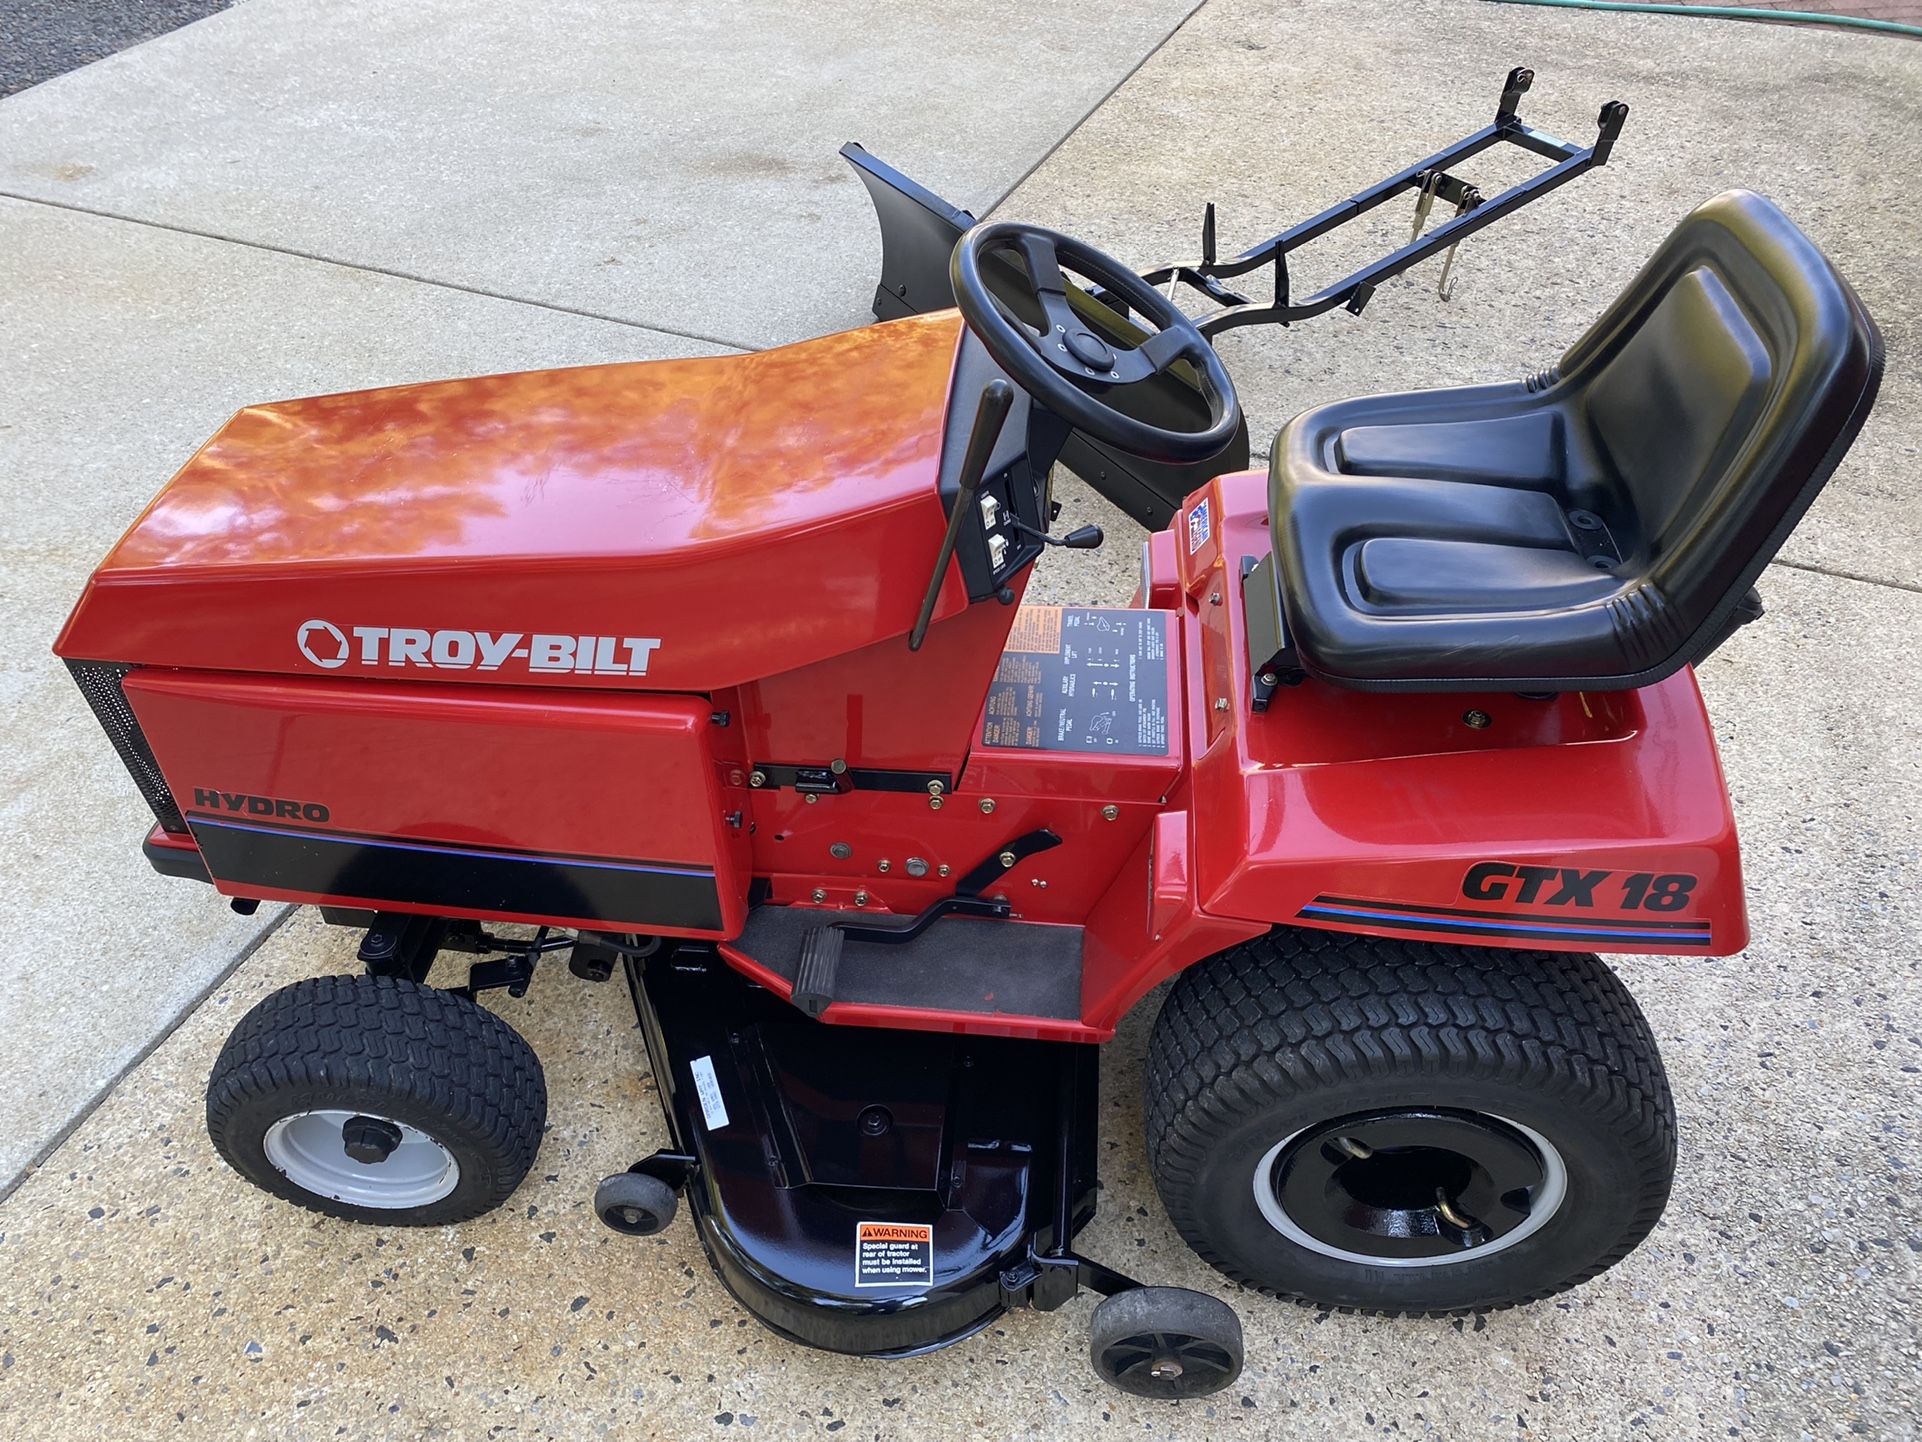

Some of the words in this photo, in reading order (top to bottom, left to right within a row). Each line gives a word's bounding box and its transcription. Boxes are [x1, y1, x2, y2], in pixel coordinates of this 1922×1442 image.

[353, 626, 662, 676] TROY-BILT
[194, 788, 330, 823] HYDRO
[1461, 862, 1613, 908] GTX
[1620, 873, 1698, 912] 18
[873, 1228, 927, 1239] WARNING
[882, 1266, 901, 1274] using
